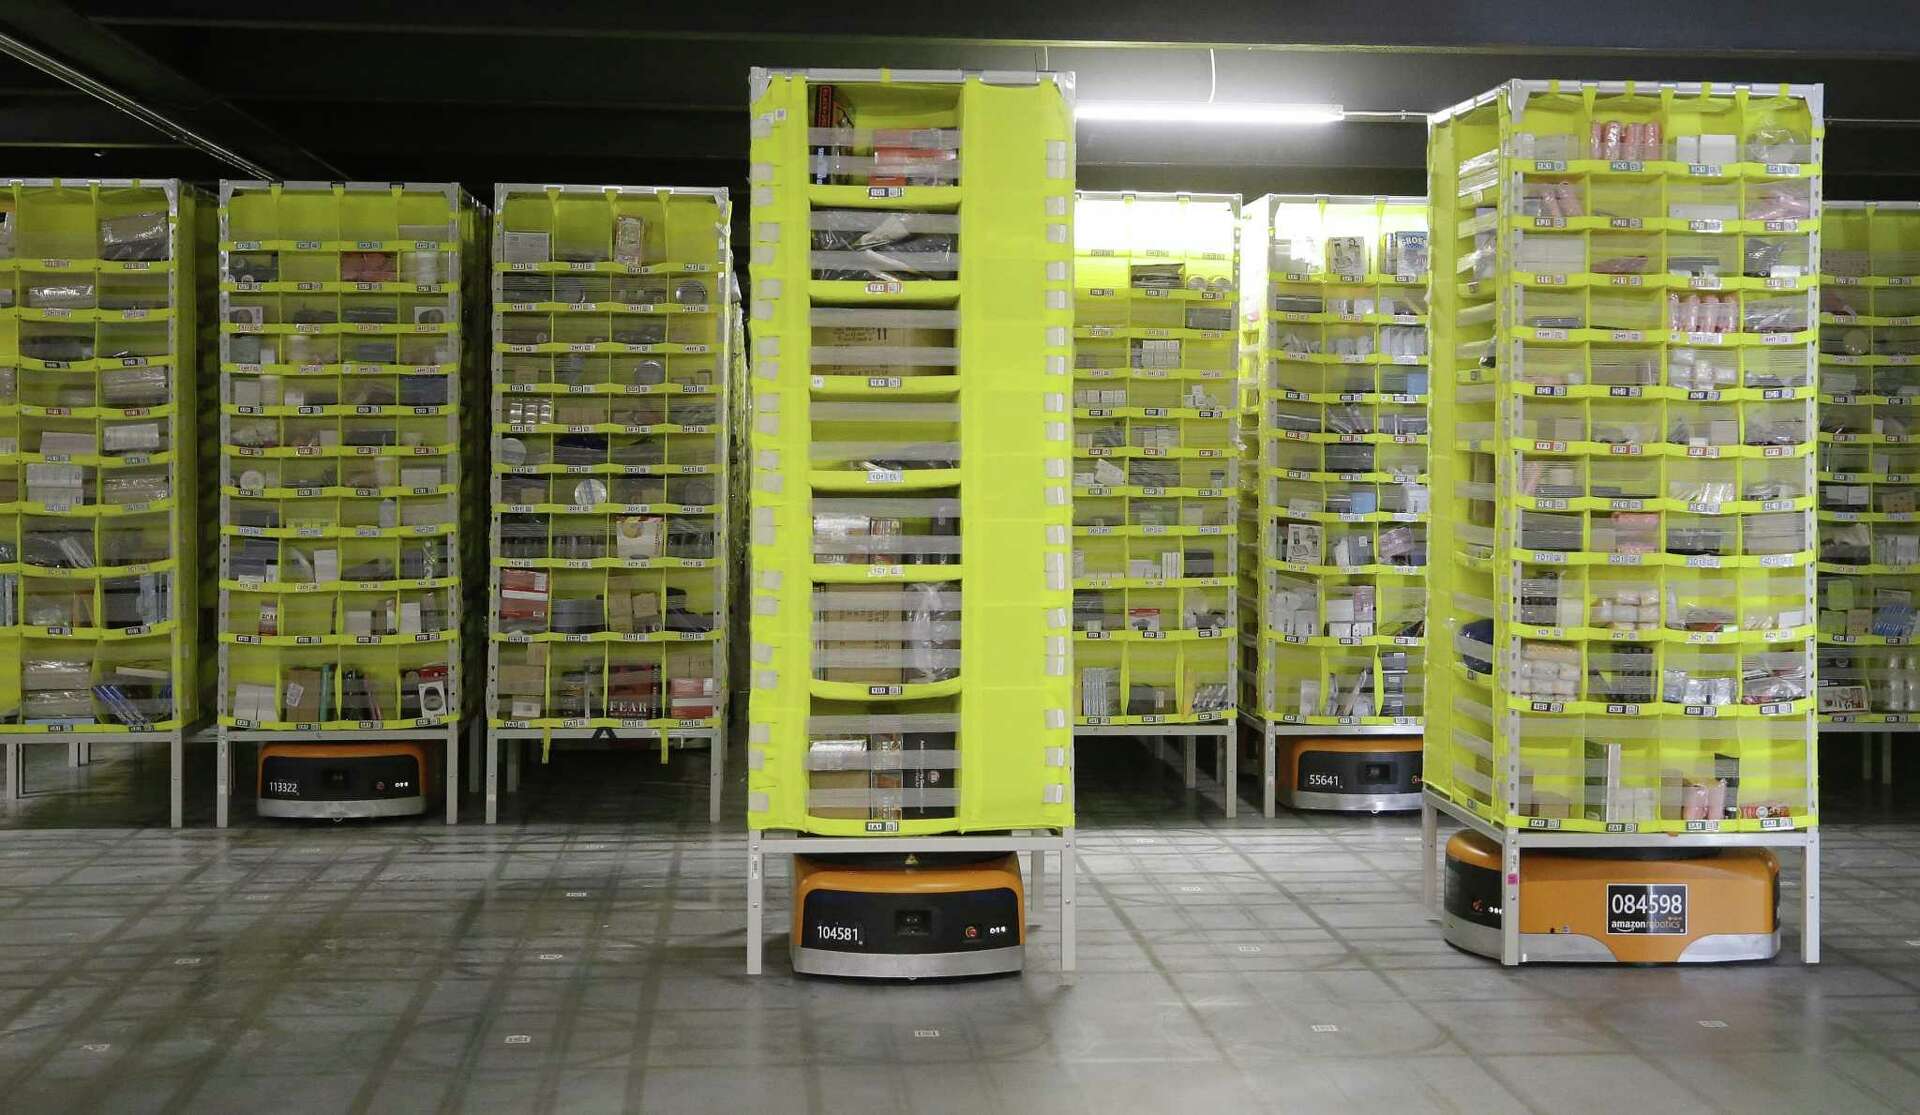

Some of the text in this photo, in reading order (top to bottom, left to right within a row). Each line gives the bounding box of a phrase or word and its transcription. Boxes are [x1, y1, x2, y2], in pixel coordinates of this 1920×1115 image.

[609, 701, 647, 713] FEAR
[270, 781, 297, 793] 113322
[1309, 774, 1339, 787] 55641
[1612, 894, 1682, 914] 084598
[817, 926, 859, 941] 104581
